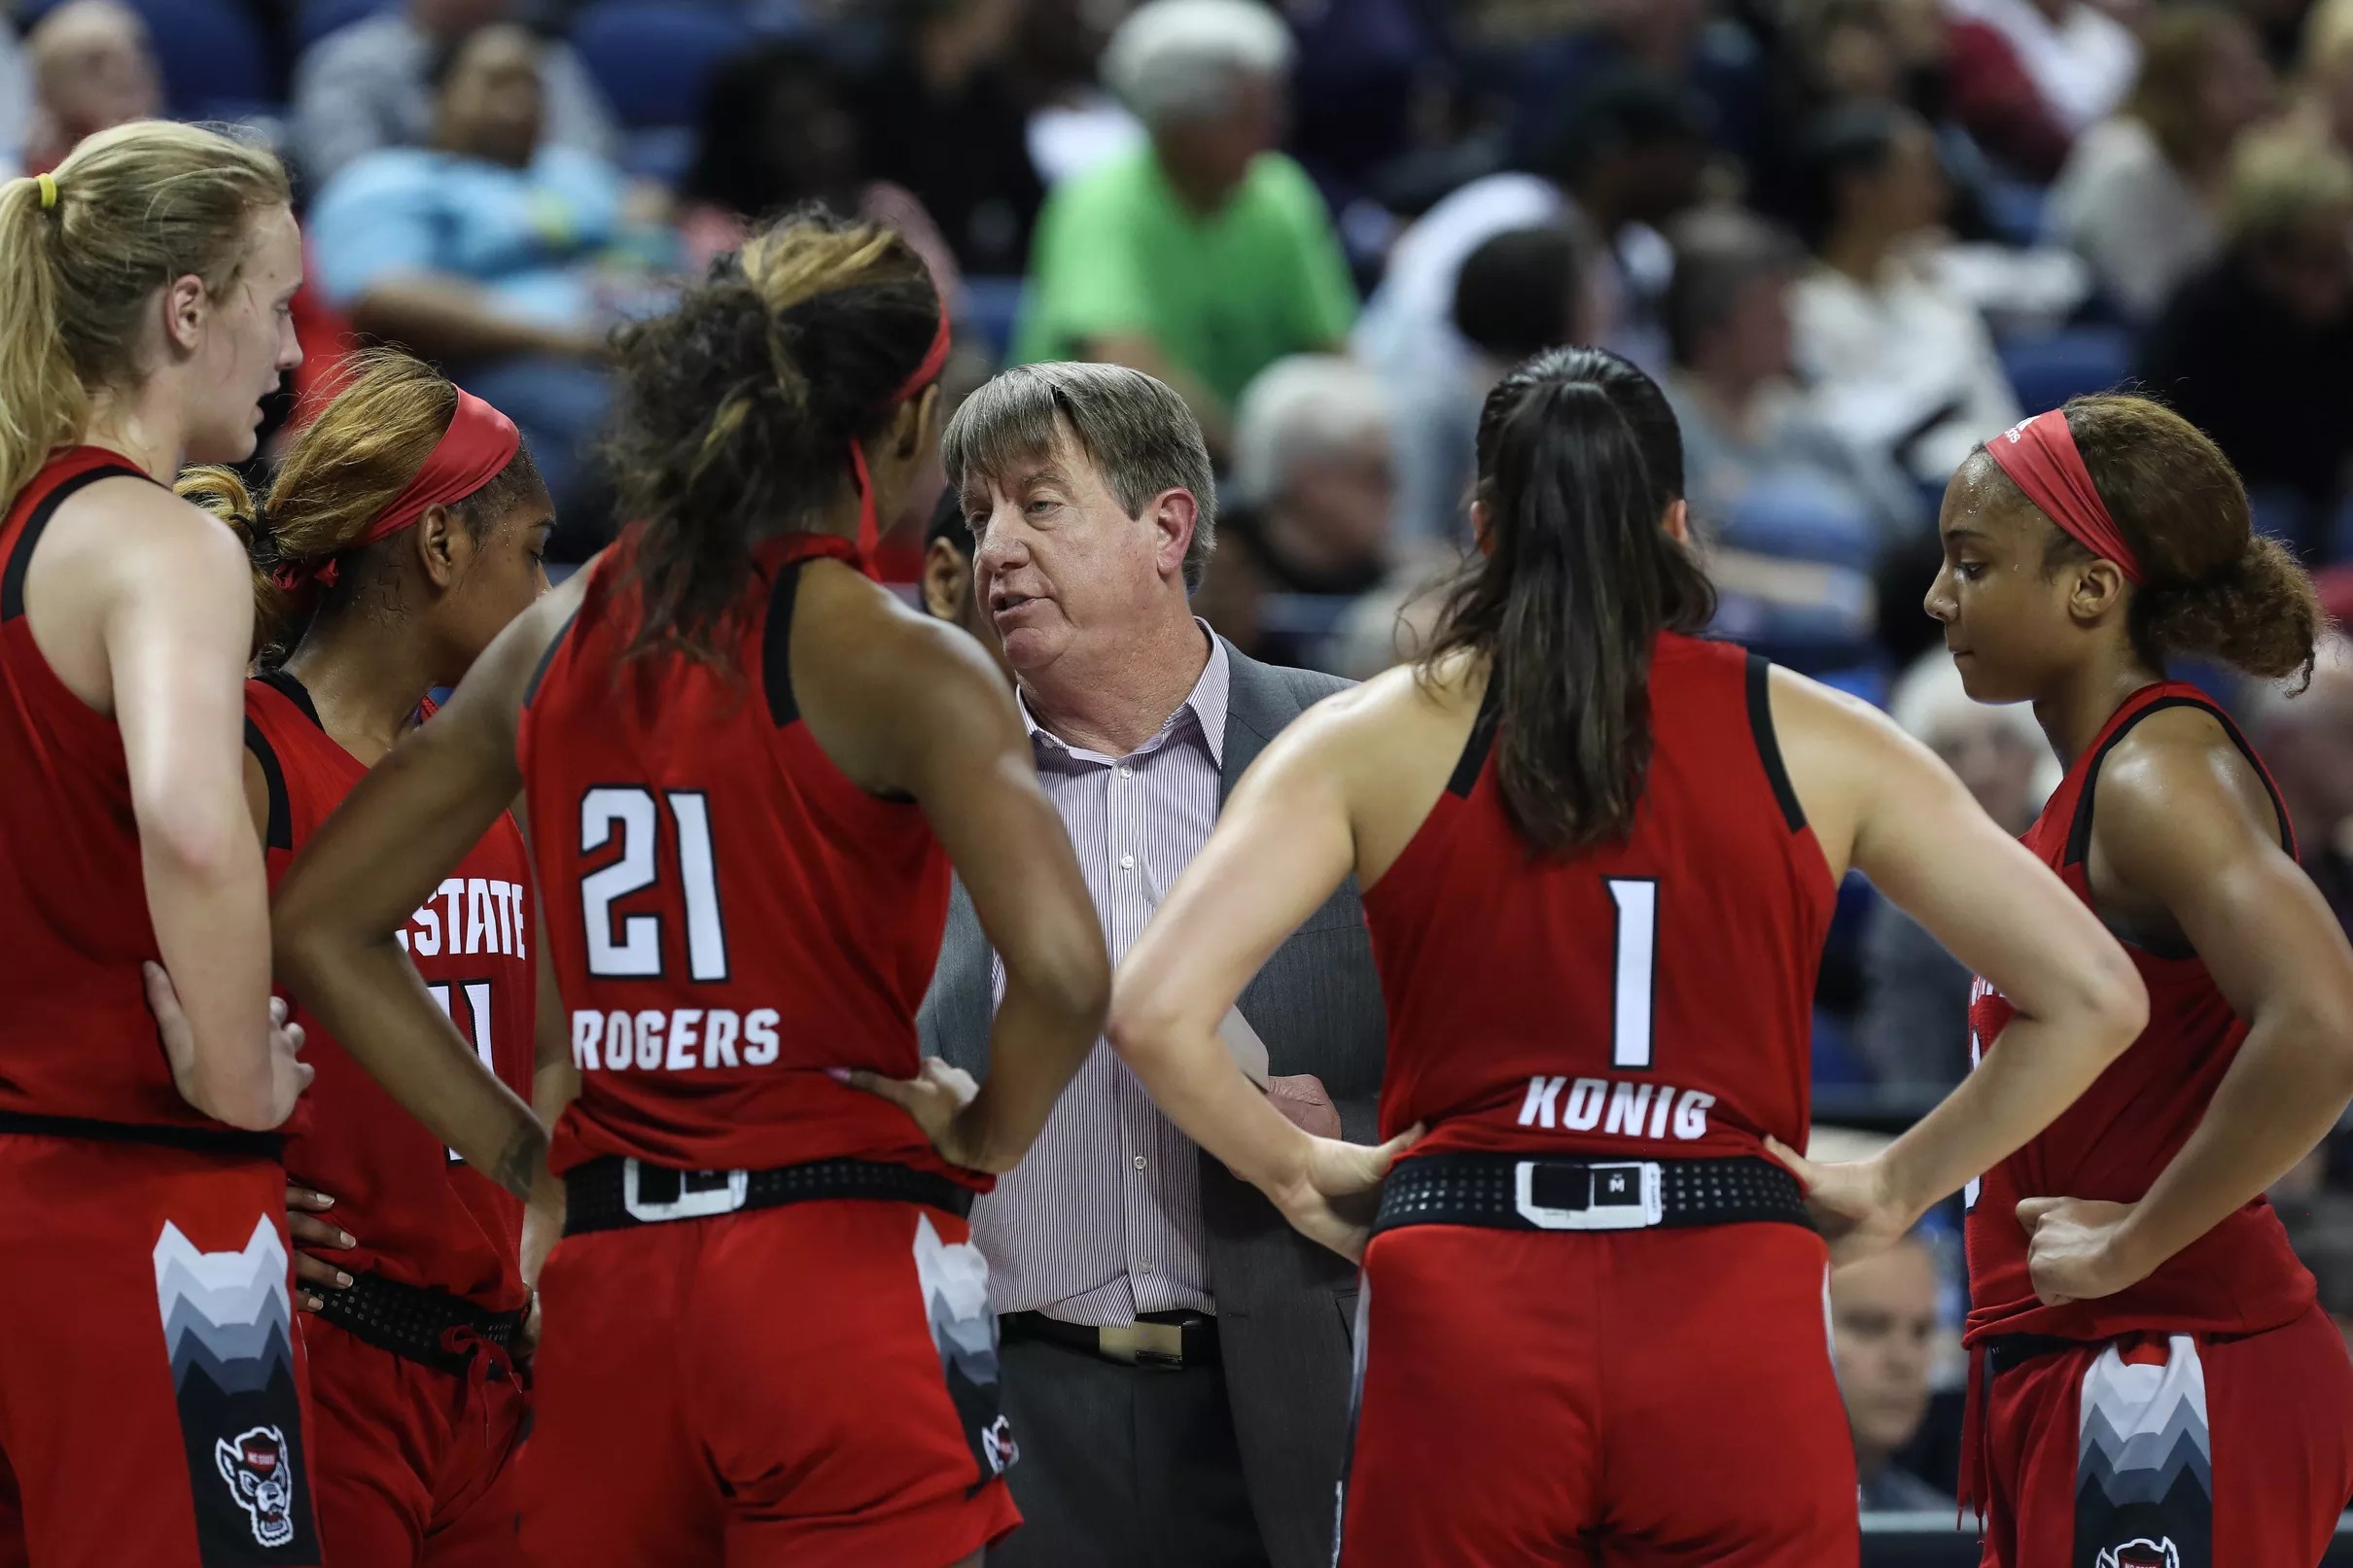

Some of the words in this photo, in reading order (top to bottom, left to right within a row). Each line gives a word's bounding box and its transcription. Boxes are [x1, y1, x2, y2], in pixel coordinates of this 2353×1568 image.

[579, 783, 730, 984] 21
[1600, 875, 1660, 1070] 1
[572, 1007, 781, 1070] ROGERS
[1517, 1075, 1716, 1140] KONIG
[1609, 1178, 1625, 1193] M
